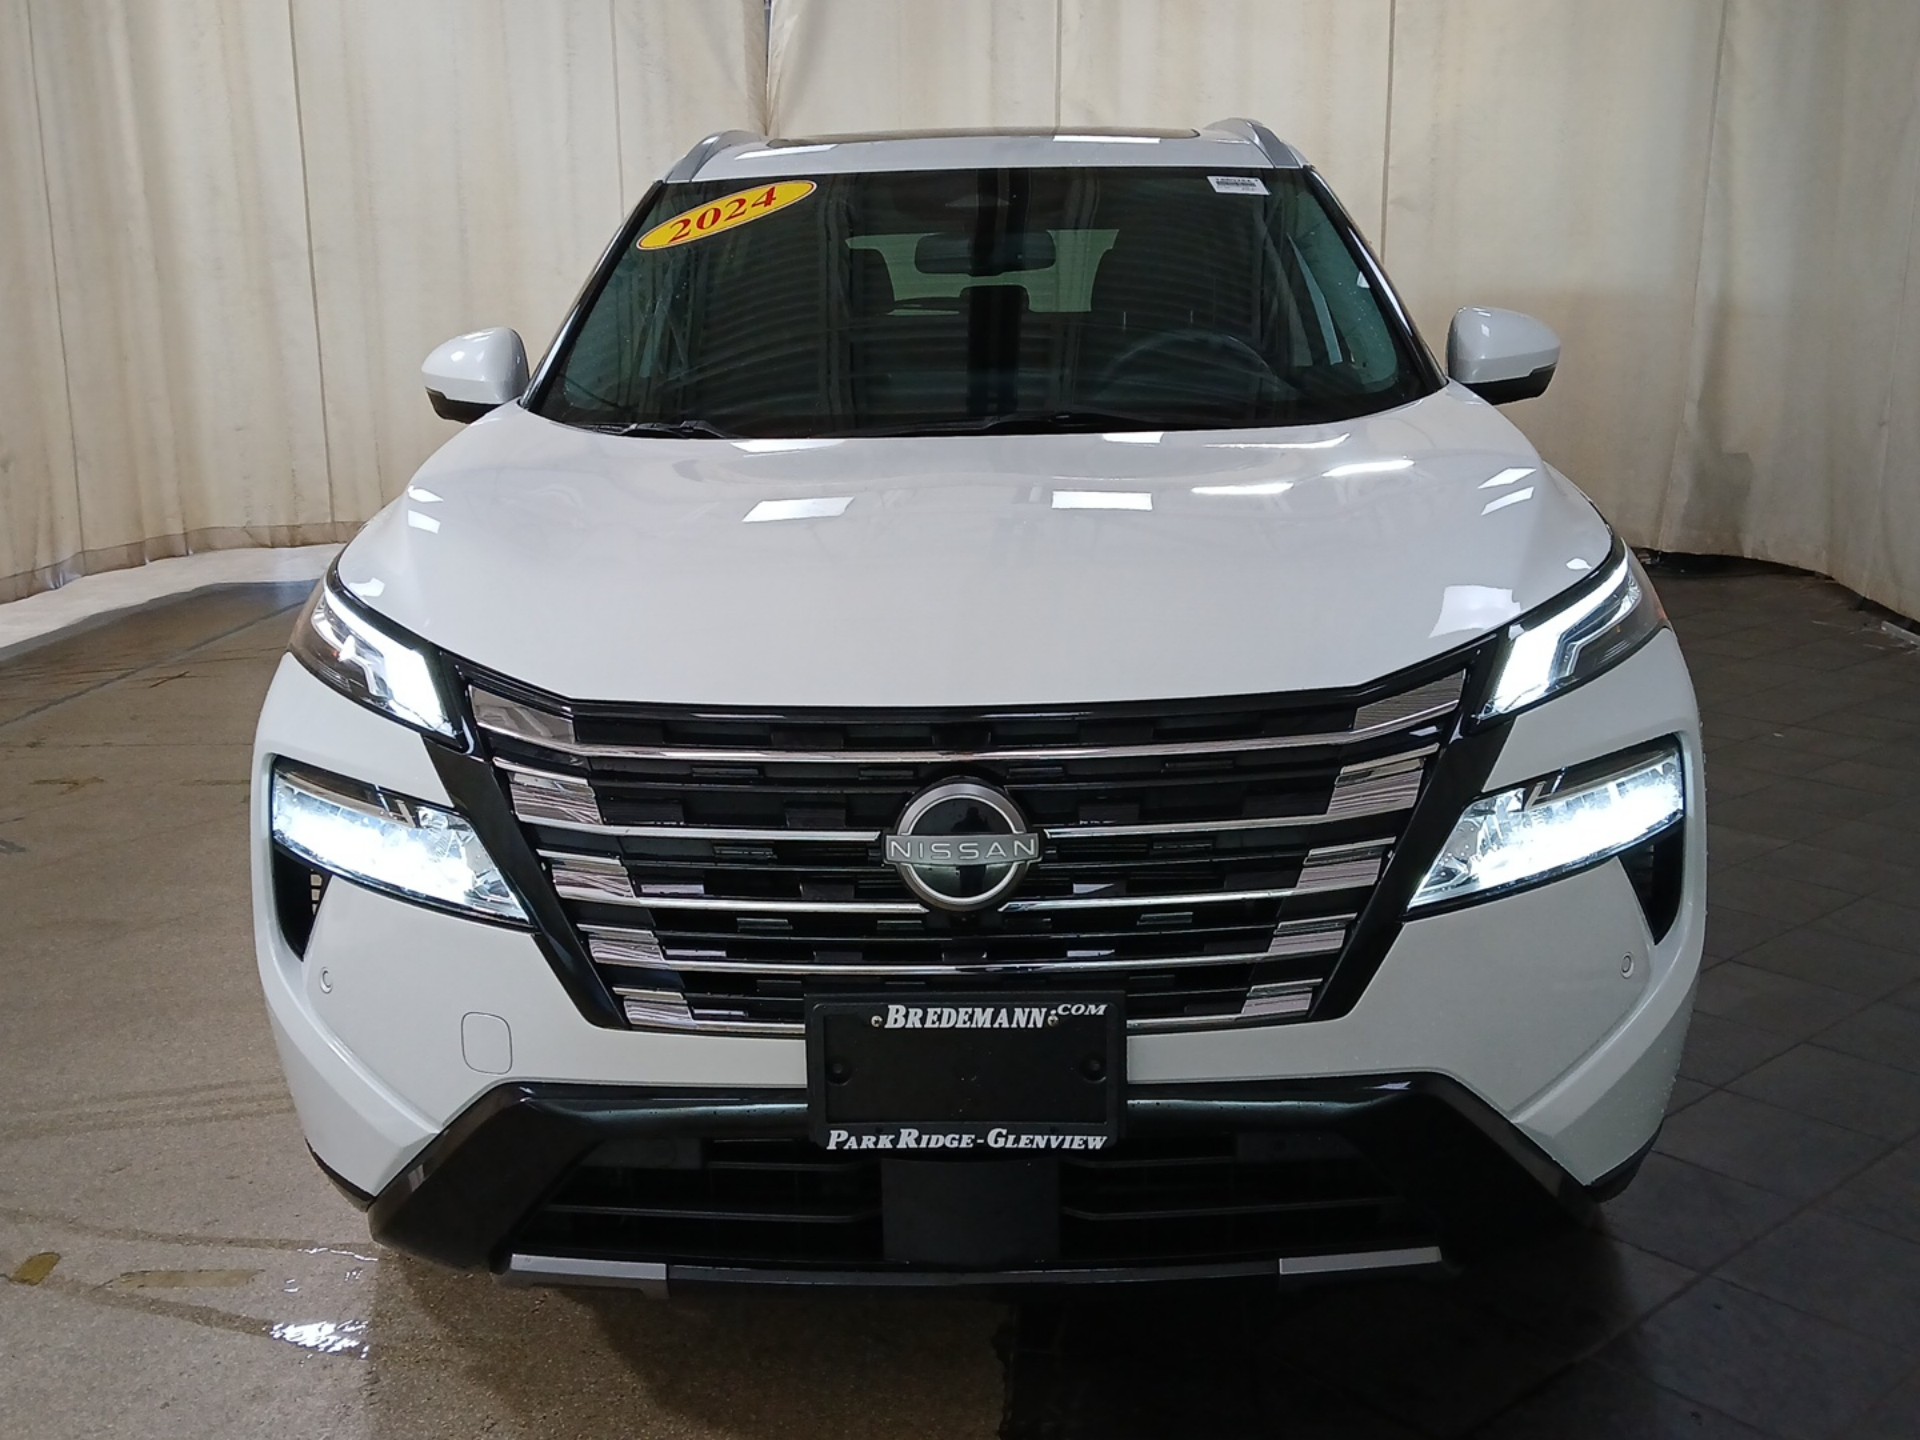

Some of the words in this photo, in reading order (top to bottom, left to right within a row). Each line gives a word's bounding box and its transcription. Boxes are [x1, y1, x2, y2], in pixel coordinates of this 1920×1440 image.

[668, 186, 776, 244] 2024
[891, 838, 1035, 860] NISSAN
[826, 1129, 895, 1150] PARK
